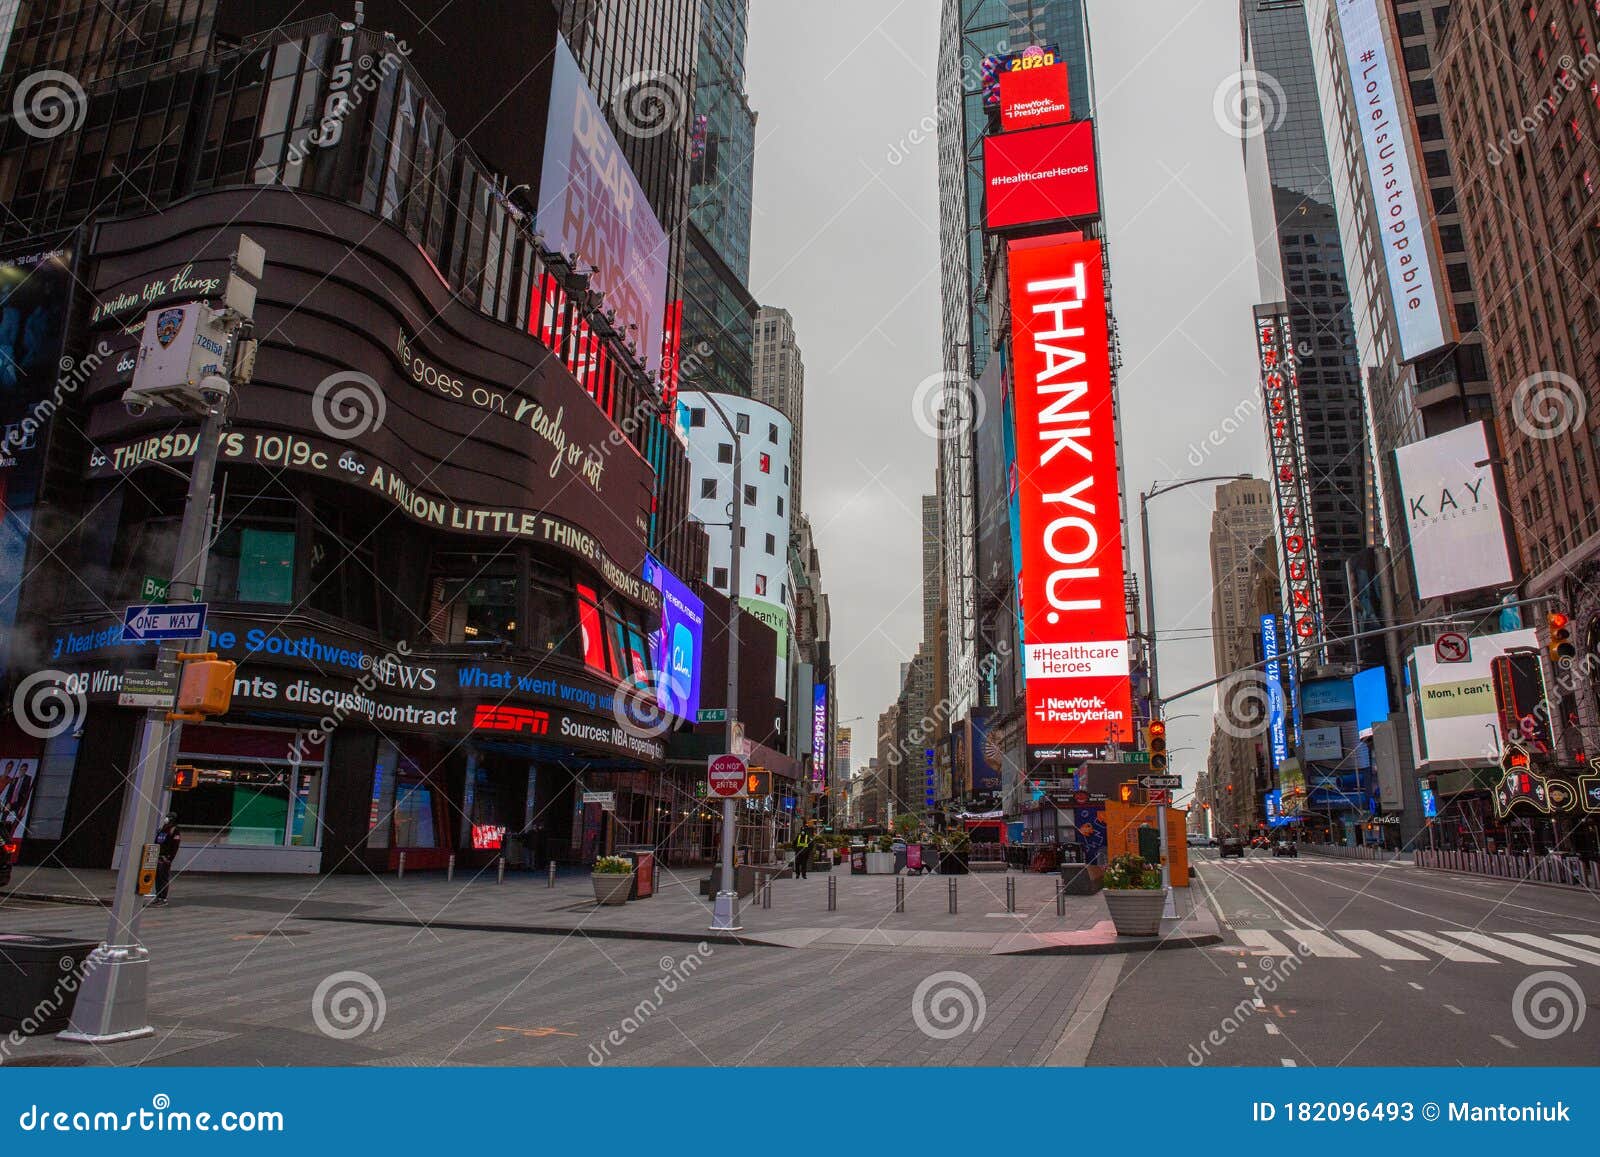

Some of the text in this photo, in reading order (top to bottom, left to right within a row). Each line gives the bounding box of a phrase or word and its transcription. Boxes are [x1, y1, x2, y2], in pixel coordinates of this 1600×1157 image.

[1011, 53, 1055, 72] 2020
[1013, 98, 1054, 112] NewYork-
[1013, 103, 1065, 118] Presbyterian
[573, 83, 634, 232] DEAR
[991, 164, 1089, 186] #HealthcareHeroes
[1359, 49, 1422, 311] #LoveIsUnstoppable
[103, 292, 139, 317] million
[142, 279, 166, 302] little
[170, 264, 220, 294] things
[116, 357, 136, 373] abc
[413, 356, 464, 398] goes
[514, 397, 567, 479] ready
[568, 443, 584, 463] or
[1027, 262, 1102, 624] THANK YOU.
[89, 452, 107, 468] bc
[1409, 477, 1484, 520] KAY
[1412, 503, 1489, 529] JEWELERS
[338, 456, 366, 475] abc
[370, 465, 385, 491] A
[388, 473, 446, 525] MILLION
[451, 507, 537, 535] LITTLE
[542, 517, 595, 559] THINGS
[600, 555, 640, 599] THURSDAYS
[1284, 507, 1314, 638] YOUNG
[136, 614, 197, 629] ONE WAY
[67, 628, 95, 653] heat
[245, 628, 365, 670] Southwest
[1032, 646, 1119, 661] #Healthcare
[1042, 660, 1092, 673] Heroes
[376, 659, 437, 691] NEWS
[458, 667, 512, 689] What
[517, 674, 557, 697] went
[559, 683, 597, 709] wrong
[1427, 688, 1455, 700] Mom,
[1463, 683, 1491, 695] can't
[65, 672, 90, 695] QB
[285, 679, 376, 720] discussing
[376, 702, 457, 726] contract
[473, 704, 549, 735] ESPN
[560, 716, 610, 743] Sources:
[611, 727, 628, 748] NBA
[1047, 698, 1106, 710] NewYork-
[1048, 708, 1123, 723] Presbyterian
[716, 781, 738, 789] ENTER
[1373, 816, 1400, 824] CHASE
